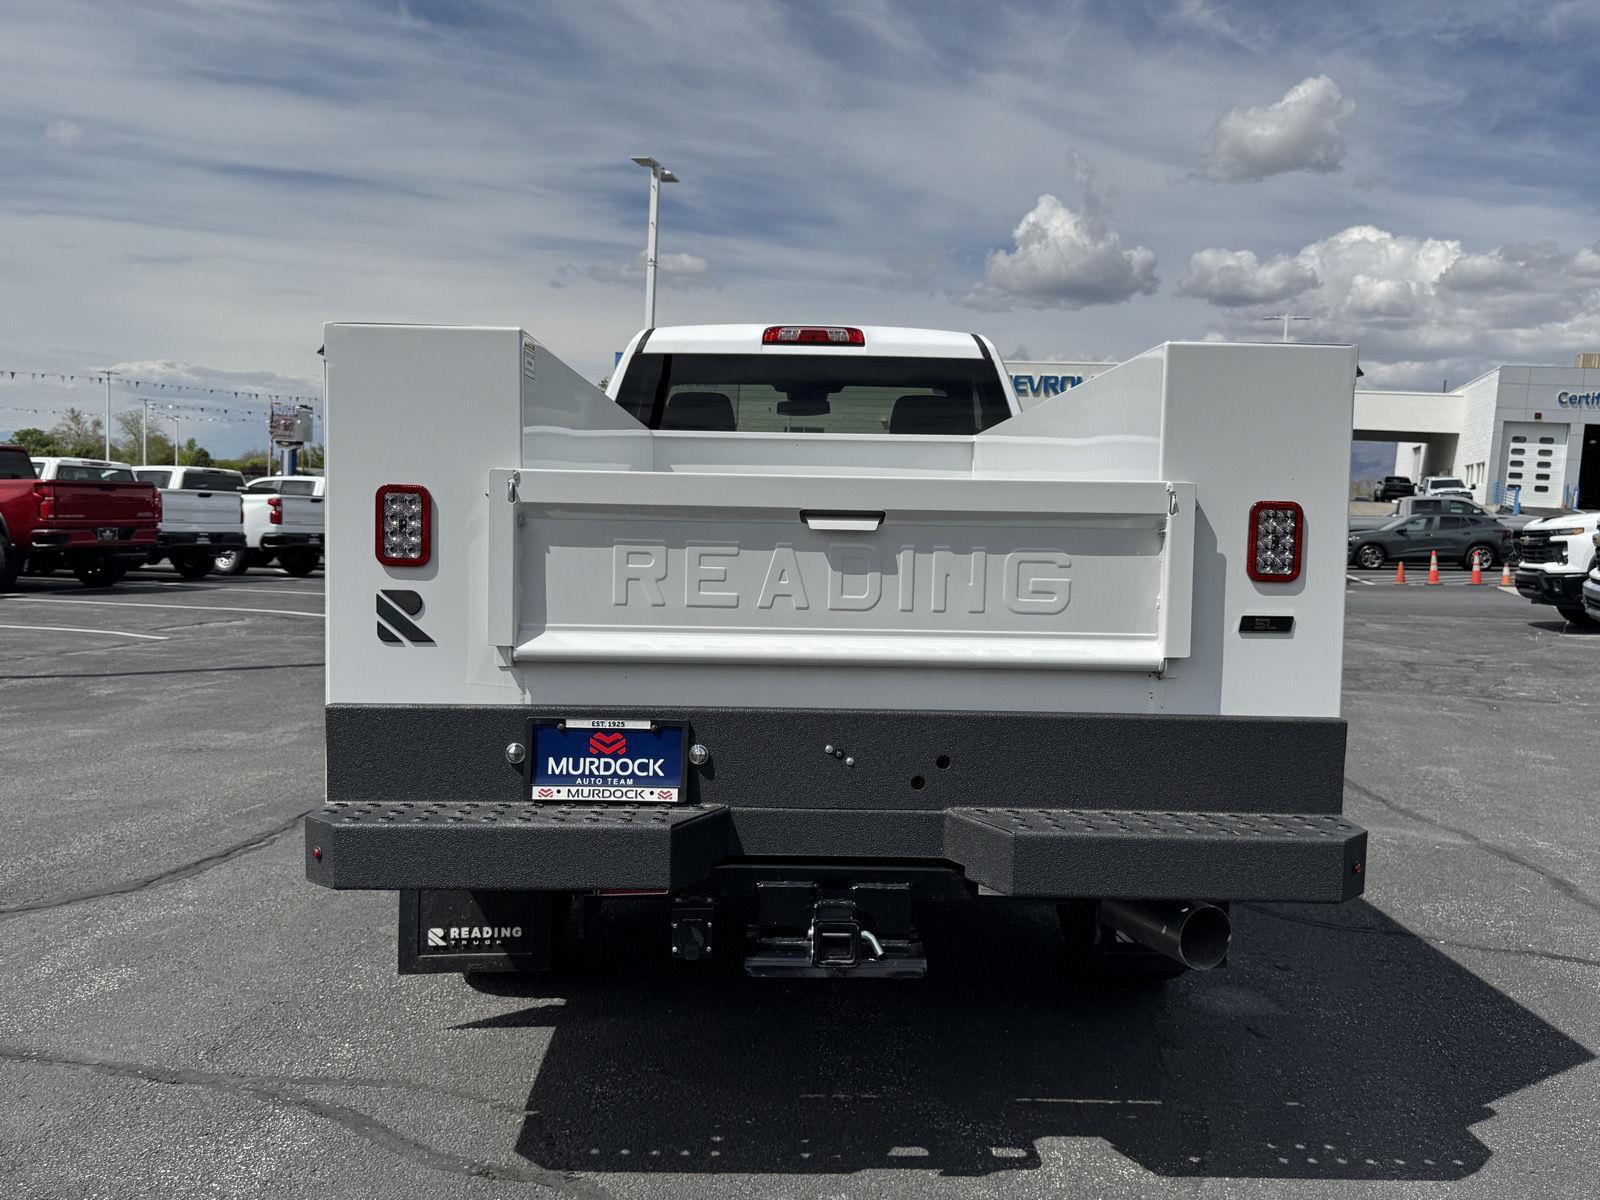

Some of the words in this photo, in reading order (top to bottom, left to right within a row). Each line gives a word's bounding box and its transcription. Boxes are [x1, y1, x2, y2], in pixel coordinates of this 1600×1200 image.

[1010, 374, 1083, 396] EVRO
[612, 538, 1072, 615] READING
[547, 757, 665, 776] MURDOCK
[576, 777, 603, 785] AUTO
[566, 788, 646, 799] MURDOCK
[450, 926, 522, 939] READING
